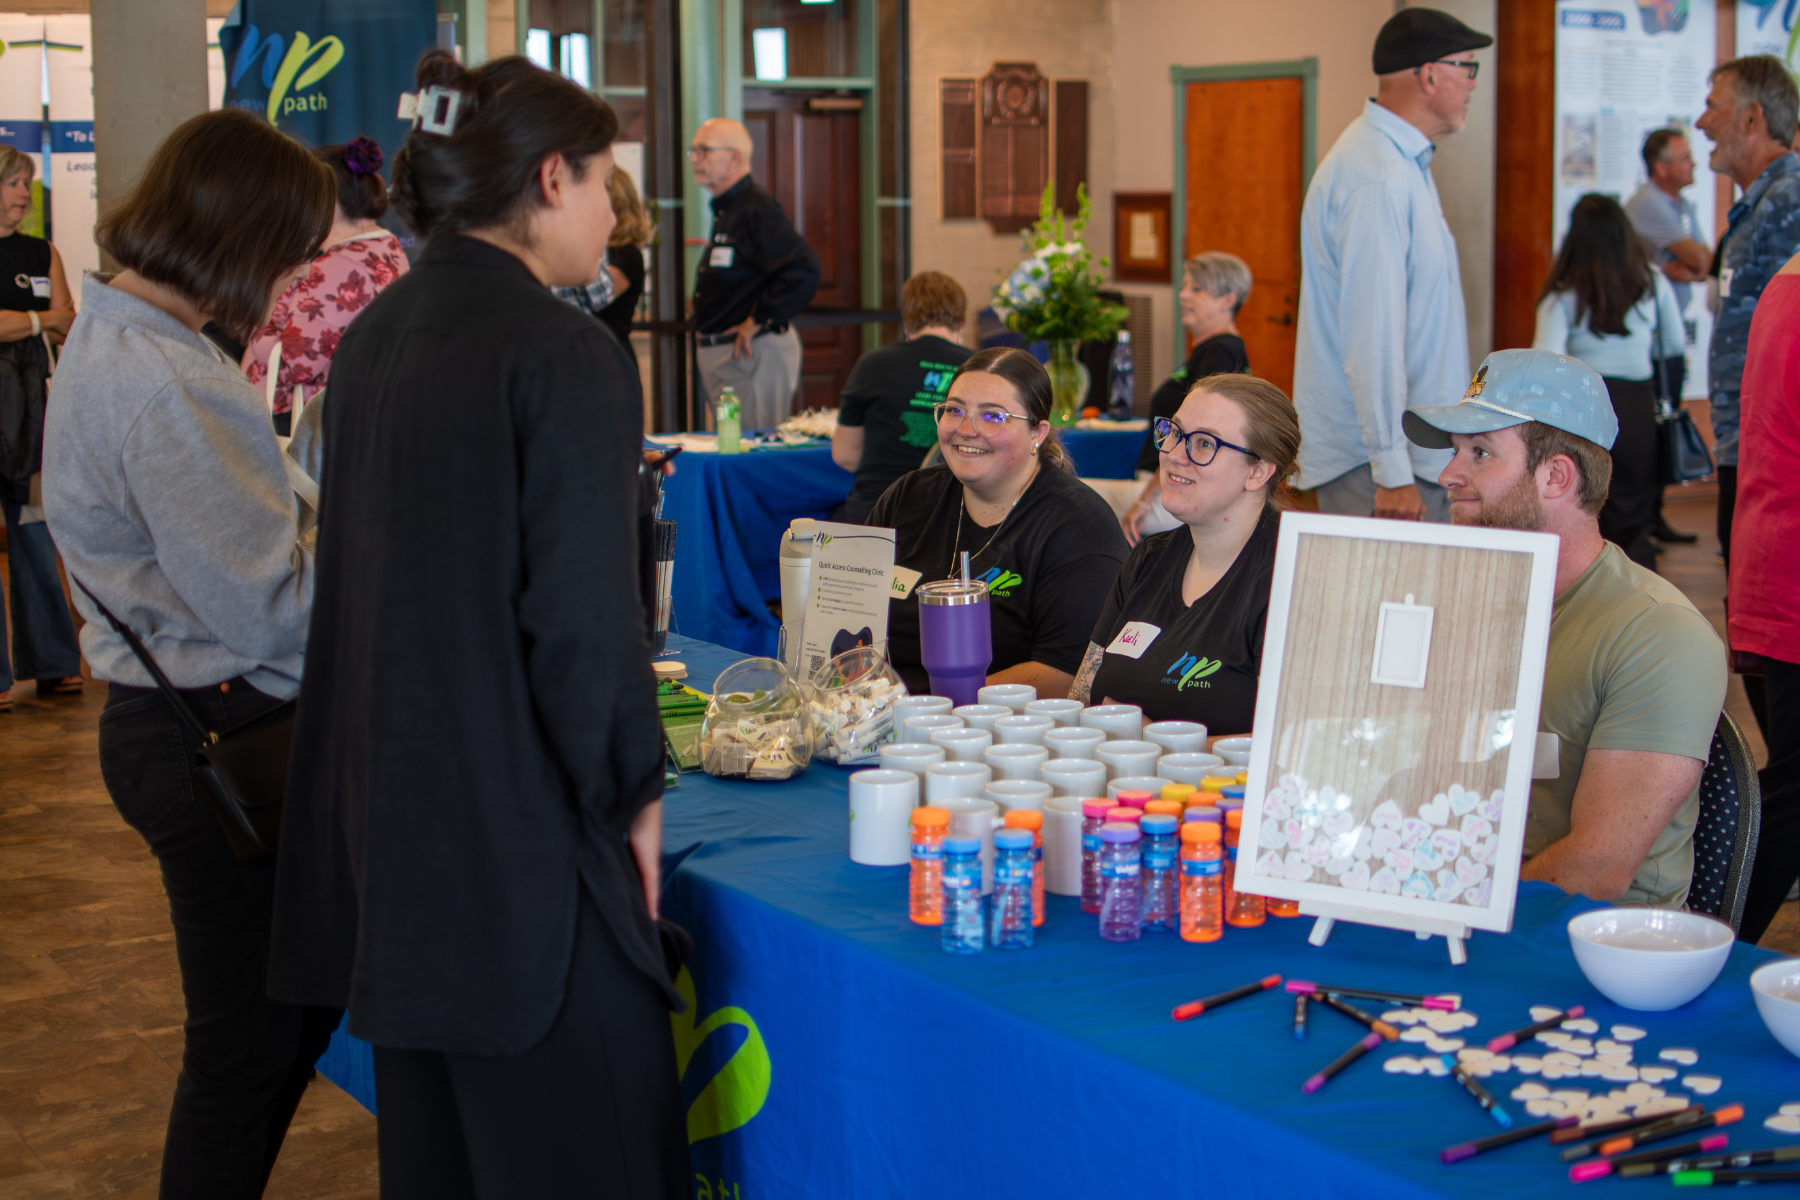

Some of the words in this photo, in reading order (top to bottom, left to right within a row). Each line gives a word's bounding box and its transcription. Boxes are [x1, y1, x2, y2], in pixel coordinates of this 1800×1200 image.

[284, 92, 328, 115] path
[818, 561, 831, 570] Quick
[832, 563, 847, 572] Access
[846, 565, 871, 576] Counselling
[872, 568, 884, 577] Clinic
[890, 577, 907, 592] lia
[991, 589, 1010, 597] path
[1119, 628, 1140, 646] Kaeli
[1161, 677, 1179, 685] new
[1187, 681, 1211, 689] path
